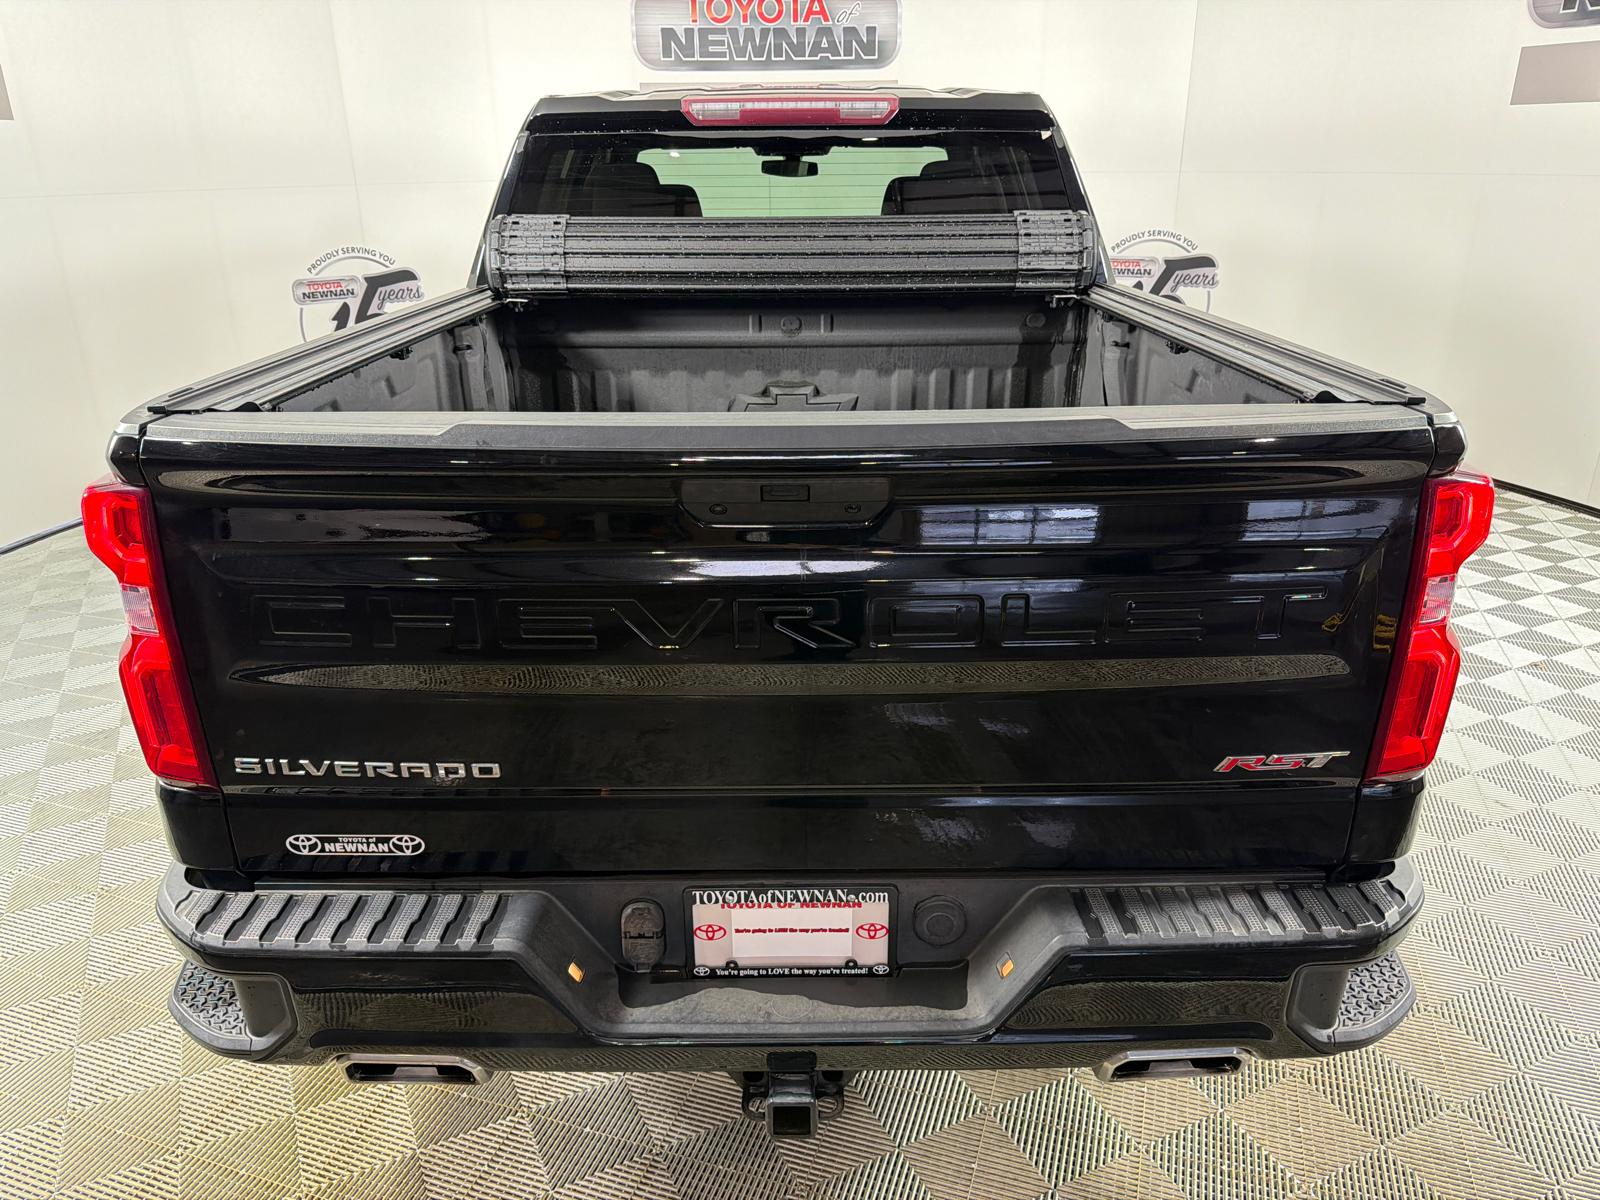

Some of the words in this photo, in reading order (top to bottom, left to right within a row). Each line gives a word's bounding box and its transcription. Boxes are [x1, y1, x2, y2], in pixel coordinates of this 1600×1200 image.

[688, 0, 831, 25] TOYOTA
[835, 3, 861, 25] of
[659, 25, 879, 61] NEWNAN
[1110, 230, 1146, 253] PROUDLY
[1147, 229, 1182, 242] SERVING
[1182, 236, 1199, 251] YOU
[306, 248, 340, 275] PROUDLY
[340, 246, 377, 257] SERVING
[378, 251, 396, 266] YOU
[306, 281, 343, 291] TOYOTA
[1172, 271, 1217, 293] years
[302, 288, 355, 300] NEWNAN
[377, 285, 422, 311] years
[250, 586, 1328, 649] CHEVROLET
[234, 757, 501, 778] SILVERADO
[1213, 750, 1350, 773] RST
[324, 843, 389, 853] NEWNAN
[739, 968, 758, 976] going
[818, 967, 840, 976] you're
